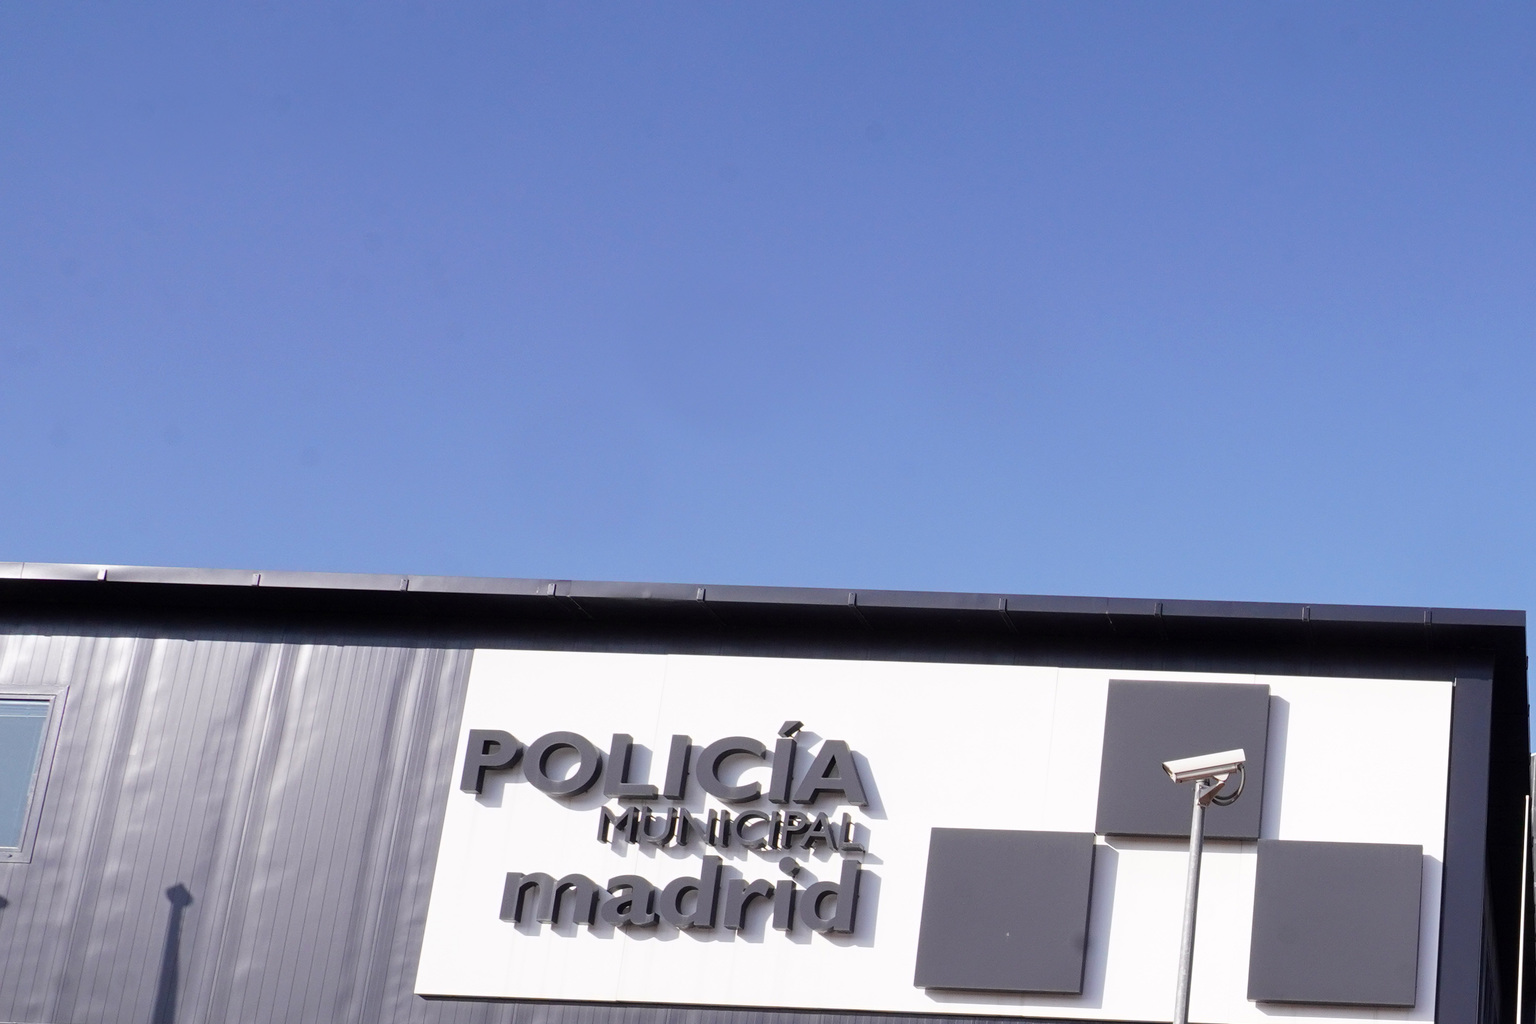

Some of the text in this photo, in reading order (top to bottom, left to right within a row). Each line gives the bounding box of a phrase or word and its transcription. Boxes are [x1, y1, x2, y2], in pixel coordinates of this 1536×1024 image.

[460, 720, 869, 807] POLICÍA
[597, 806, 866, 853] MUNICIPAL
[499, 855, 863, 935] madrid
